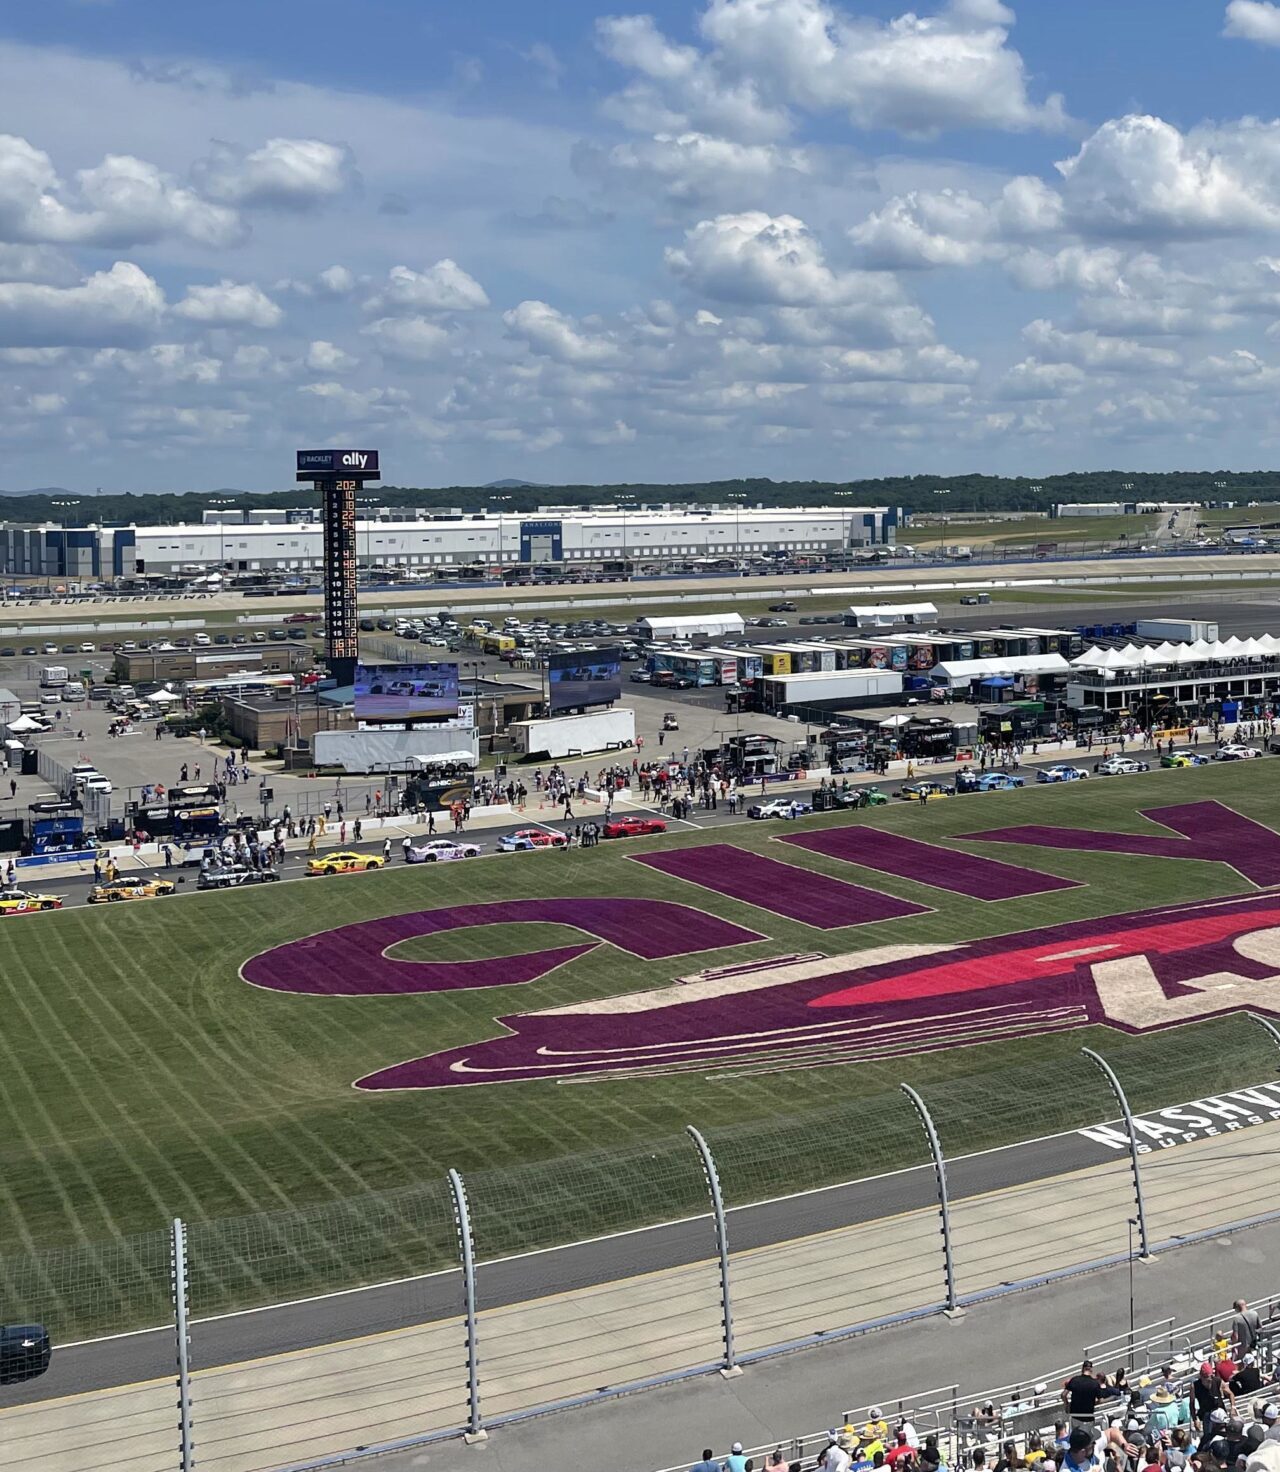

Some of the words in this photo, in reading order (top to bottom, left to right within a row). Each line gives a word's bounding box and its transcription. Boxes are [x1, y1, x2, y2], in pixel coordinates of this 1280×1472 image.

[342, 452, 368, 469] ally
[50, 593, 217, 605] SUPERSPEEDWAY
[342, 860, 356, 870] 34
[17, 900, 28, 911] 8
